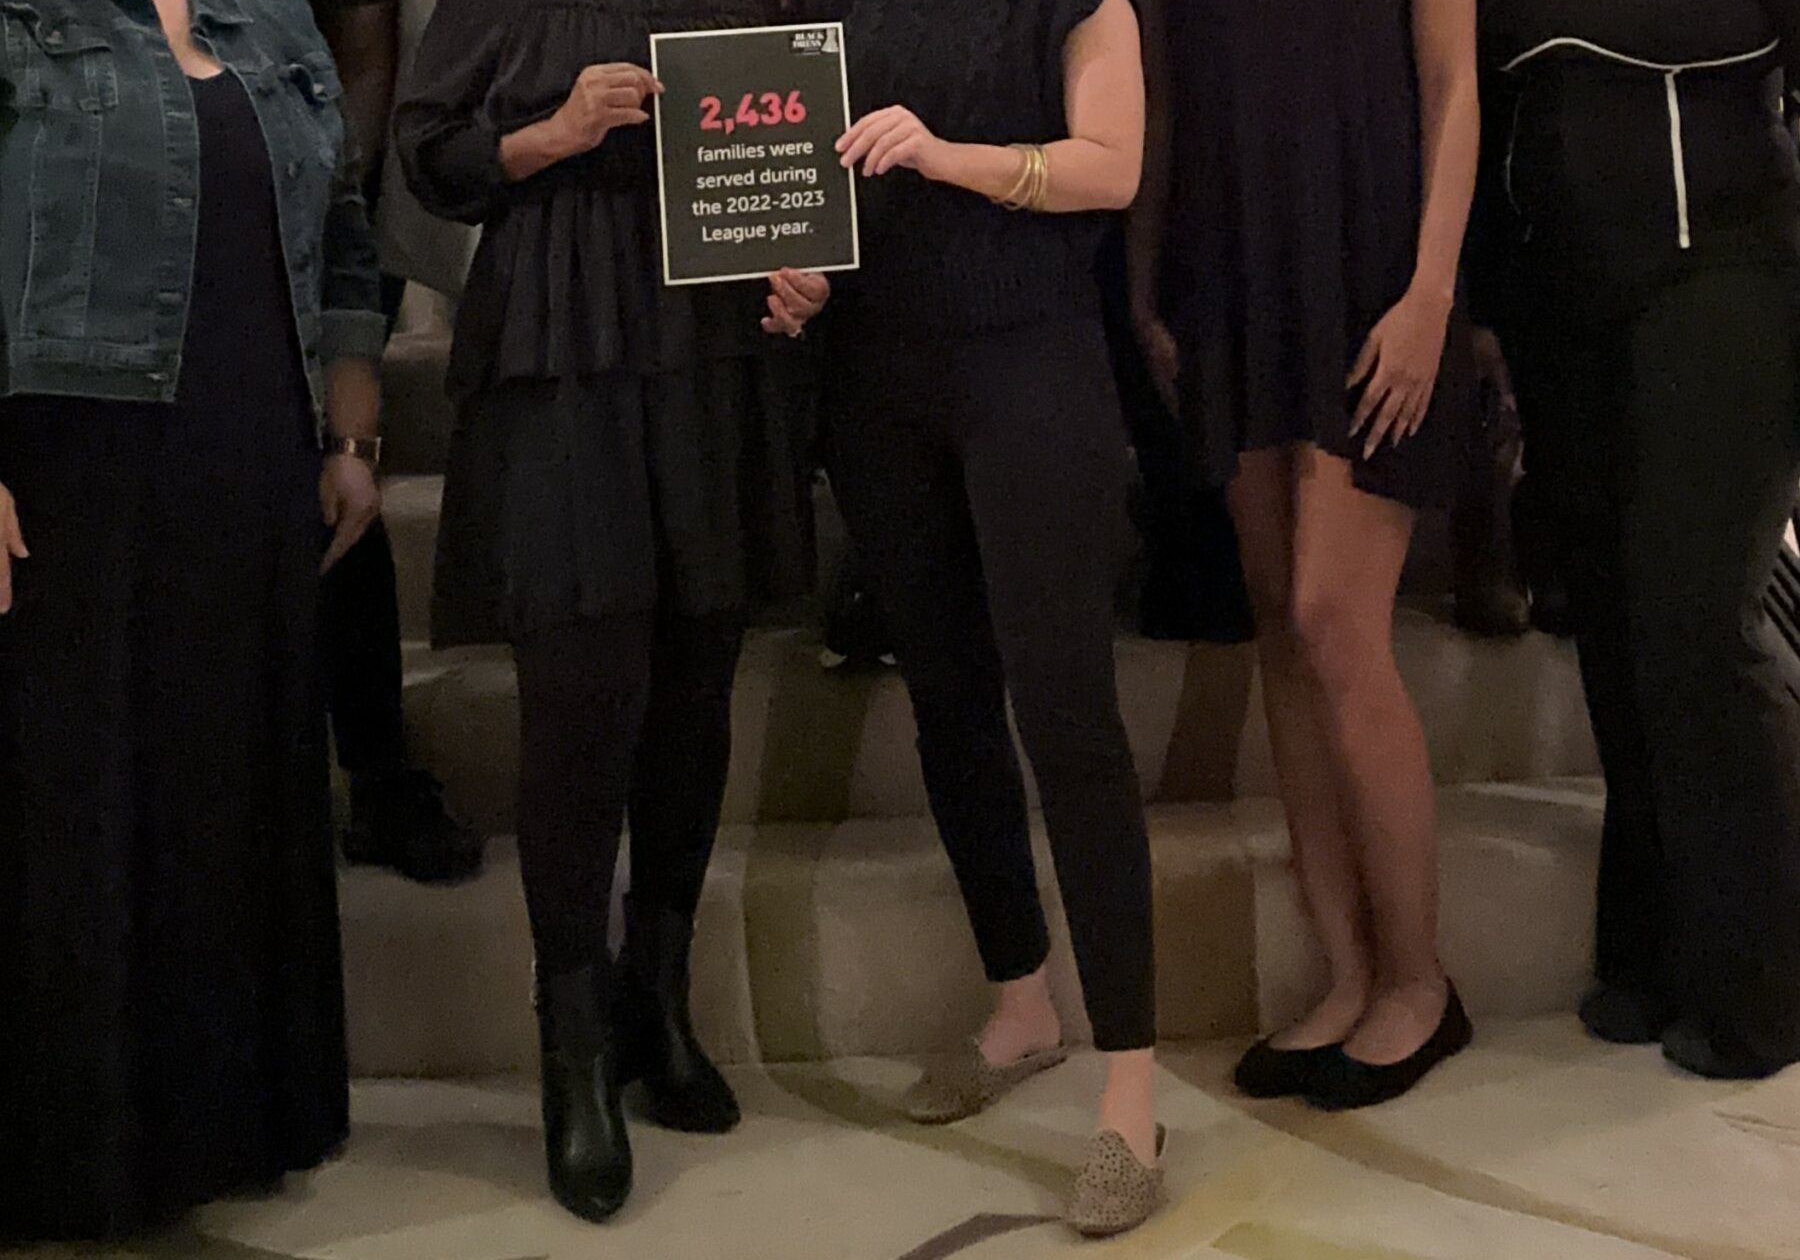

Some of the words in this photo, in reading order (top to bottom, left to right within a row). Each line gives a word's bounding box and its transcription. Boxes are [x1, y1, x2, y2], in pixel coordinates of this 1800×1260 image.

[794, 32, 825, 41] BLACK
[699, 90, 807, 135] 2,436
[697, 143, 765, 162] families
[769, 140, 814, 156] were
[696, 169, 755, 189] served
[759, 166, 817, 186] during
[692, 199, 722, 216] the
[726, 190, 825, 213] 2022-2023
[701, 225, 767, 244] League
[770, 222, 814, 240] year.
